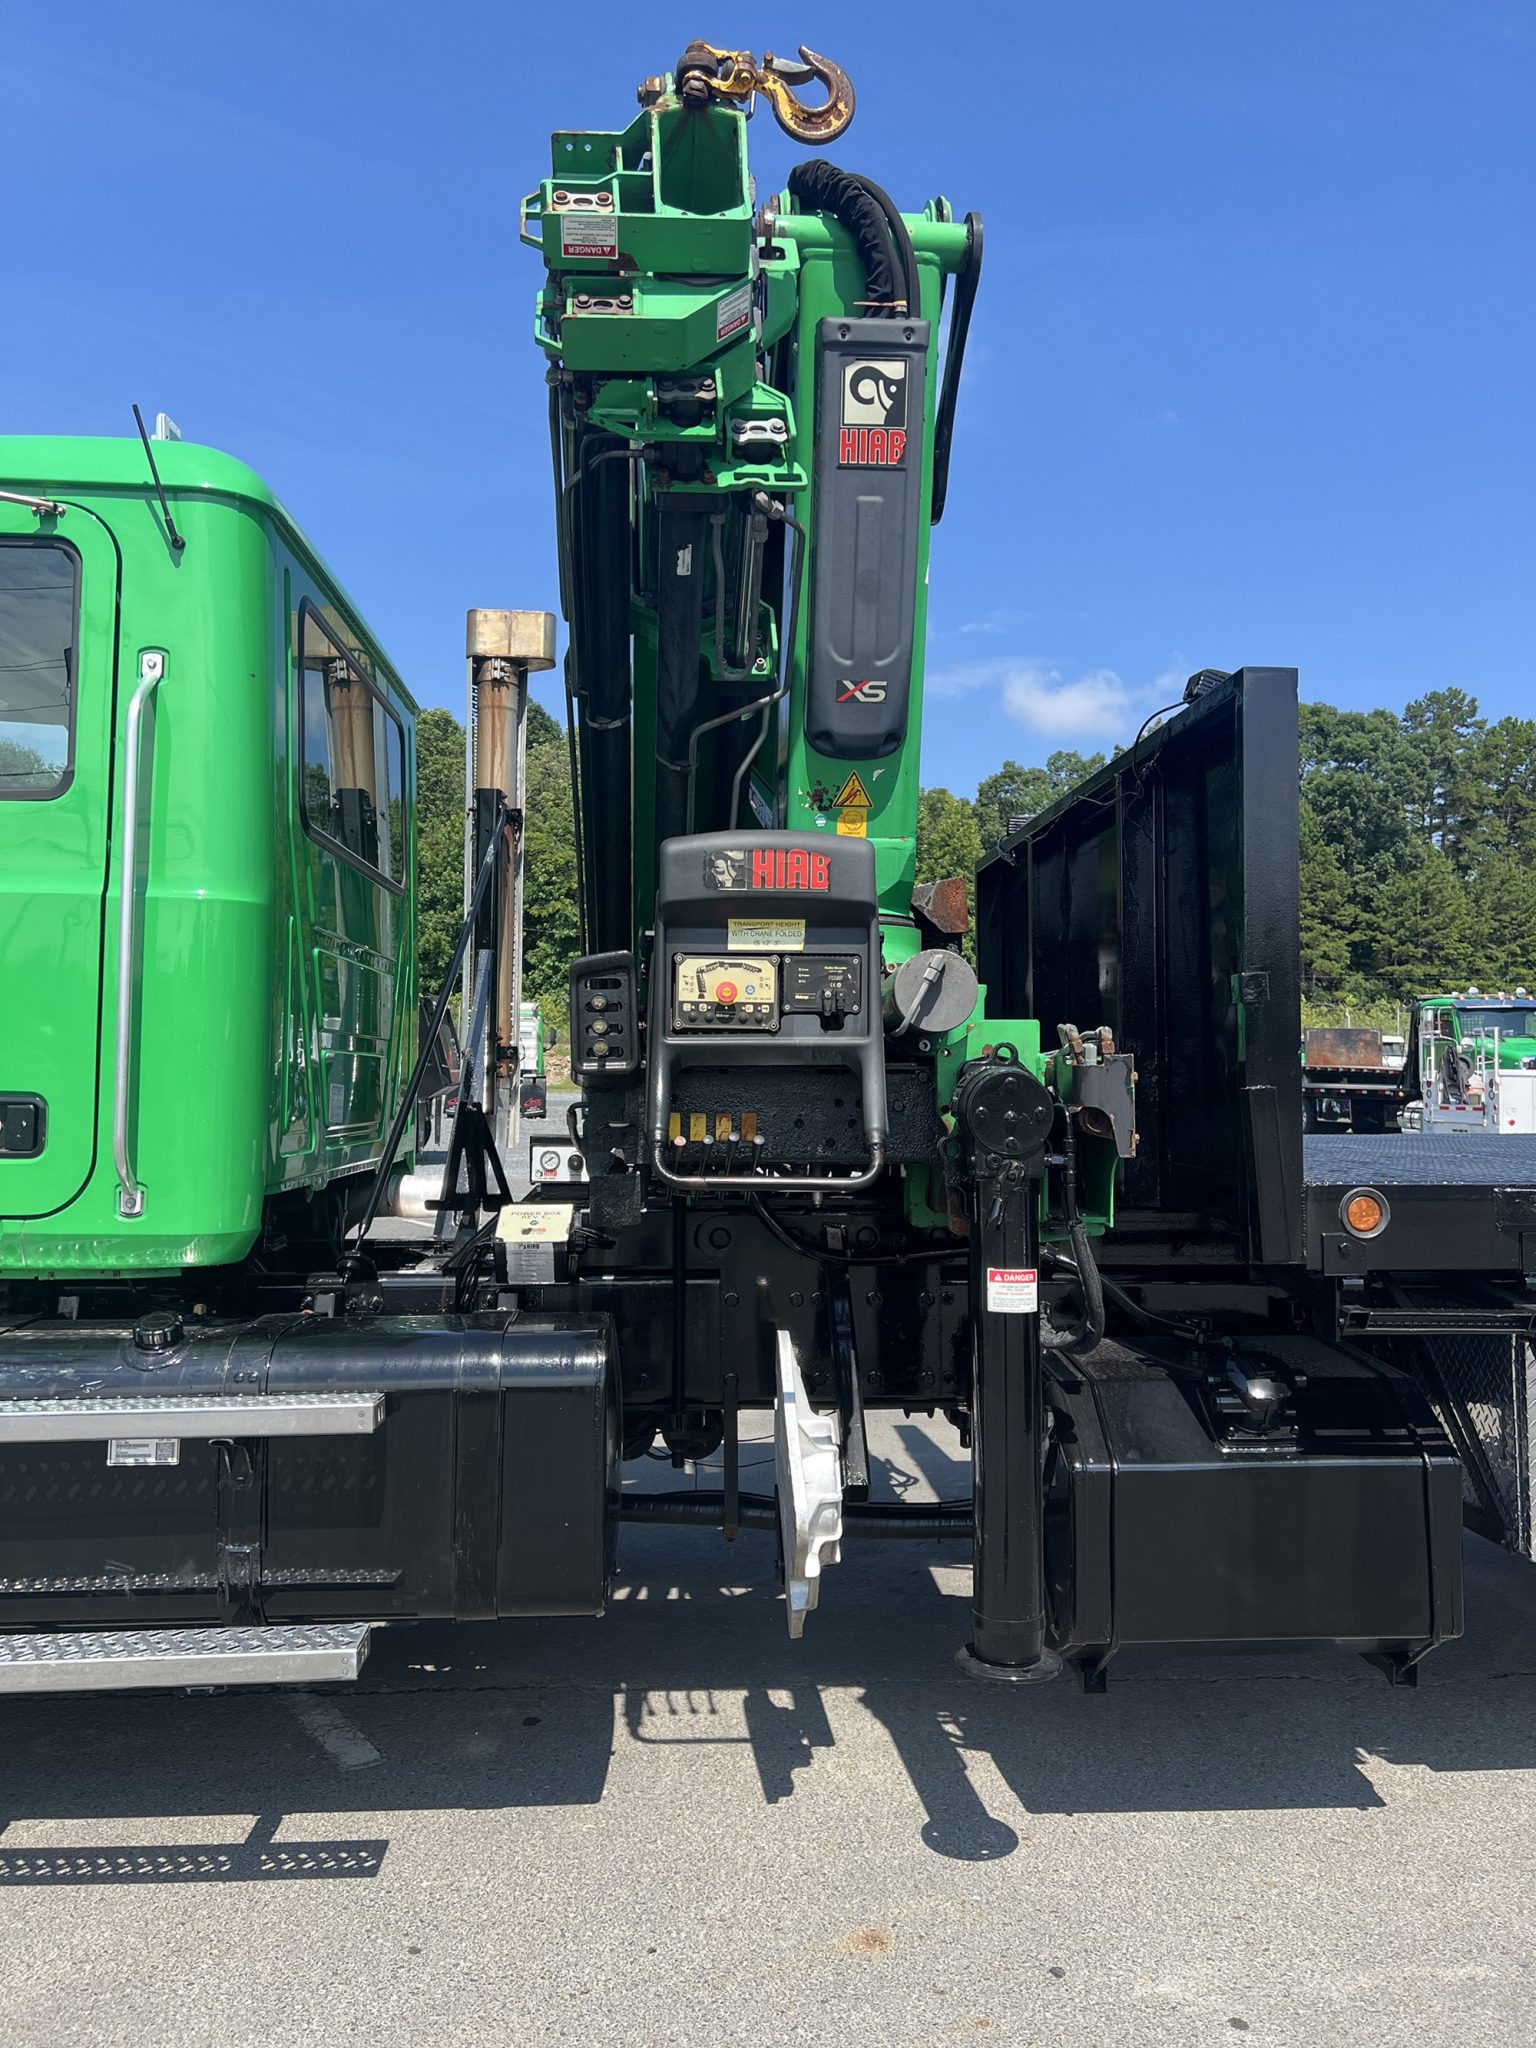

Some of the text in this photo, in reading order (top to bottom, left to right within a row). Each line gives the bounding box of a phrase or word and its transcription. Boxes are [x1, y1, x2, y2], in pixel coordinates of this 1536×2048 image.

[568, 245, 602, 255] DANGER
[840, 428, 906, 465] HIAB
[836, 679, 888, 703] XS
[752, 848, 832, 890] HIAB
[750, 930, 774, 938] CRANE
[775, 930, 802, 938] FOLDED
[1003, 1273, 1034, 1281] DANGER
